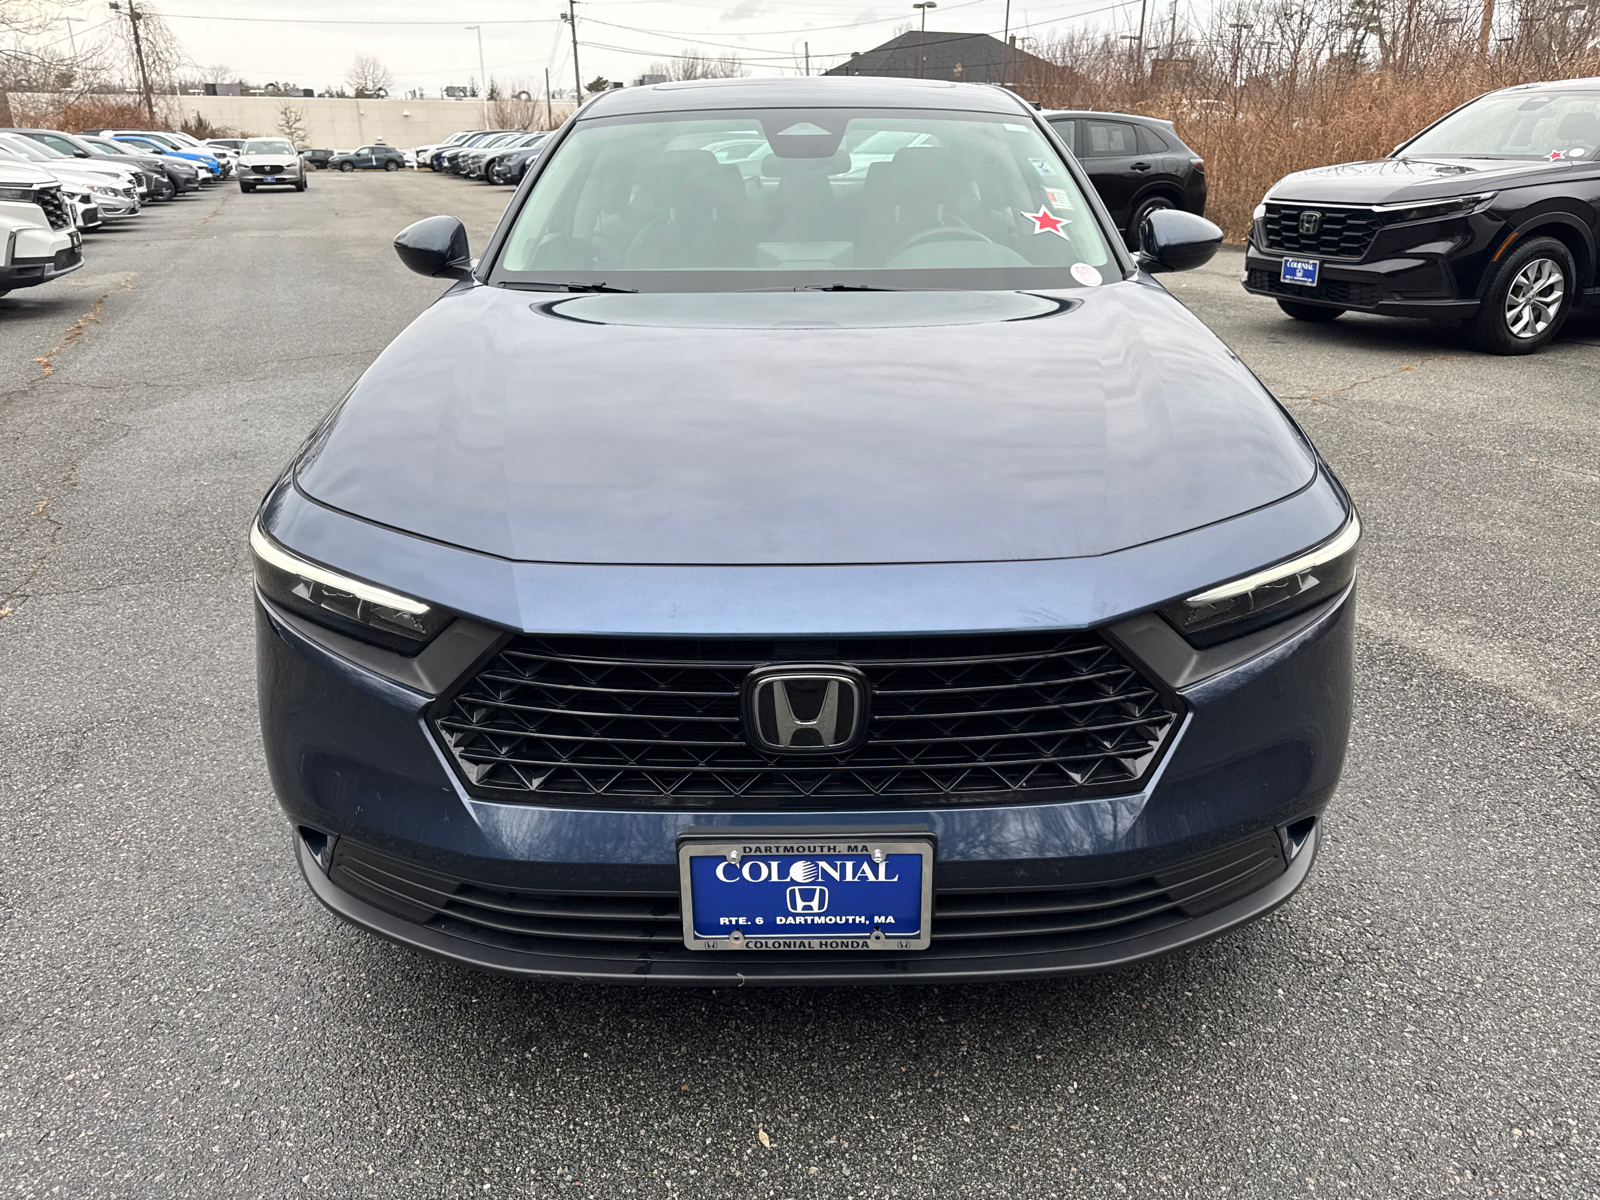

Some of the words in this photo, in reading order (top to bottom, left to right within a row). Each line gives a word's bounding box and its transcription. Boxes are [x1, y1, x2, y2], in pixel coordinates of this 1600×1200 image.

[847, 845, 869, 853] MA
[715, 860, 899, 883] COLONIAL
[719, 917, 751, 926] RTE.
[755, 916, 764, 925] 6
[776, 916, 869, 925] DARTMOUTH,
[873, 915, 896, 924] MA
[745, 940, 815, 949] COLONIAL
[819, 939, 870, 949] HONDA
